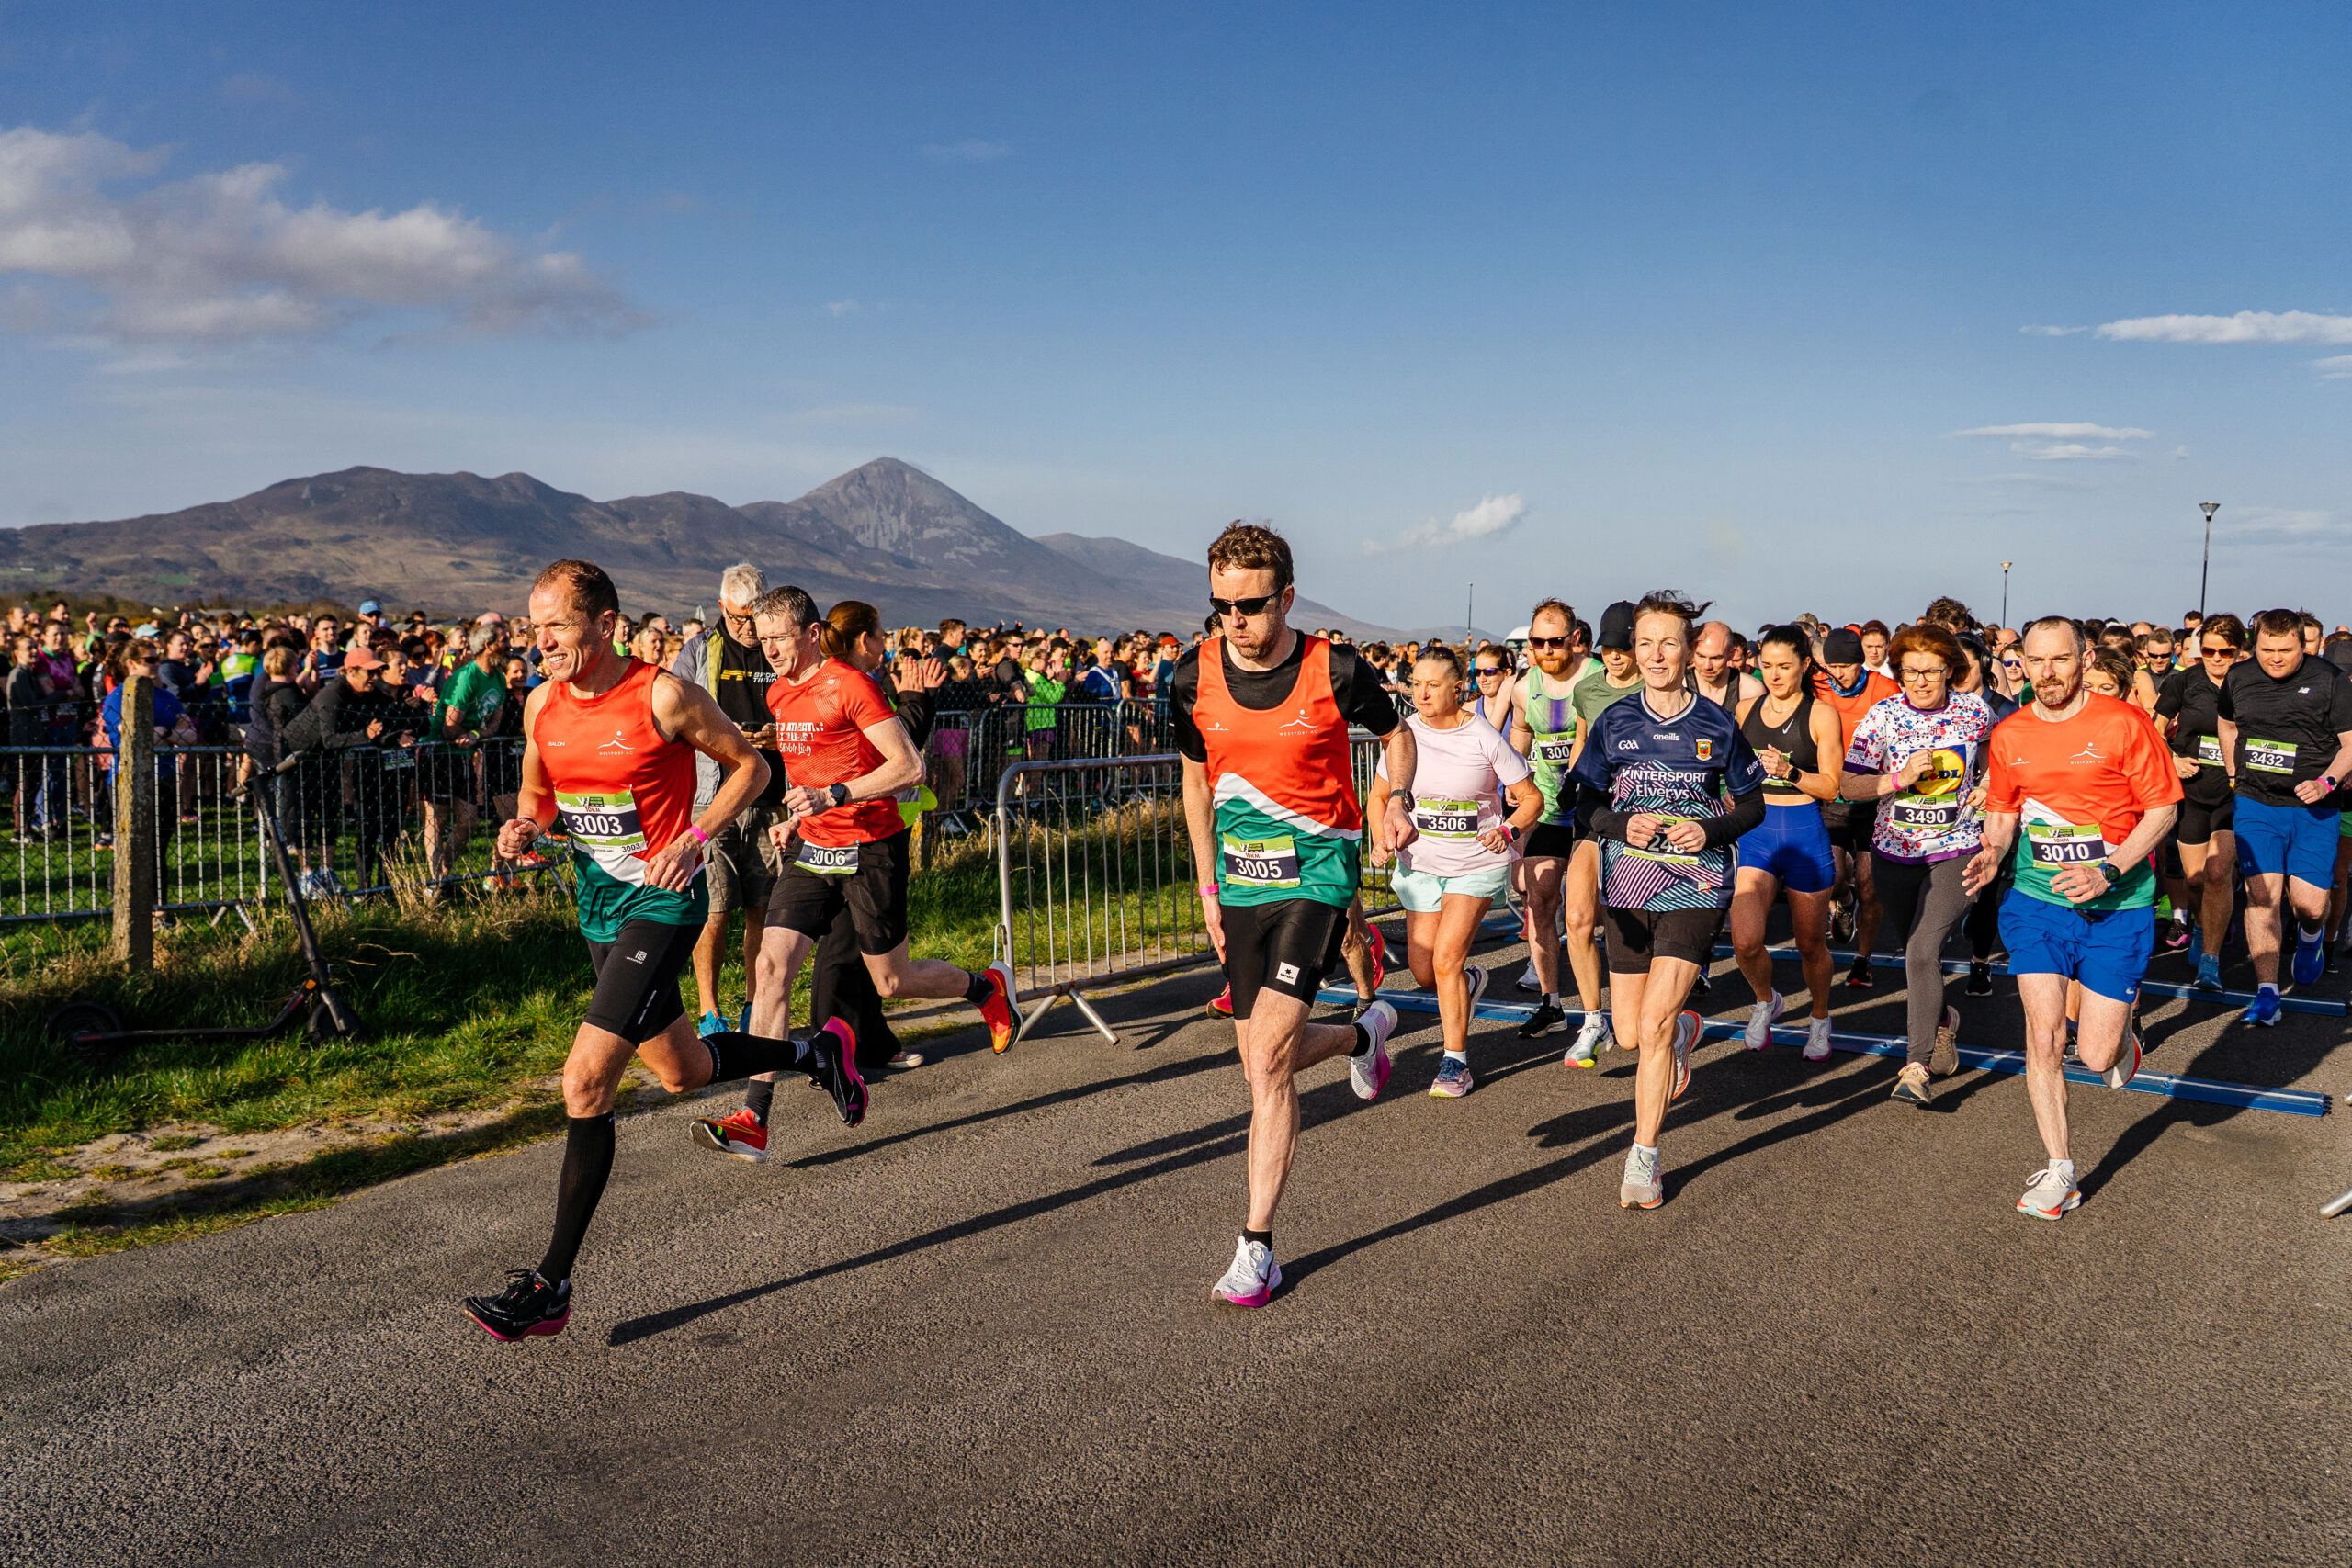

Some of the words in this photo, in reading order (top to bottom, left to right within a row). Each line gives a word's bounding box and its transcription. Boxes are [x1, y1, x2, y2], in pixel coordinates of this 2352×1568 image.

[1546, 746, 1570, 760] 300
[2208, 749, 2223, 761] 35
[2249, 751, 2284, 767] 3432
[1630, 769, 1707, 783] INTERSPORT
[1635, 784, 1690, 801] Elverys
[1428, 816, 1467, 830] 3506
[1905, 808, 1947, 824] 3490
[571, 814, 623, 835] 3003
[621, 842, 641, 852] 3003
[2041, 843, 2090, 862] 3010
[809, 847, 845, 866] 3006
[1235, 857, 1283, 879] 3005
